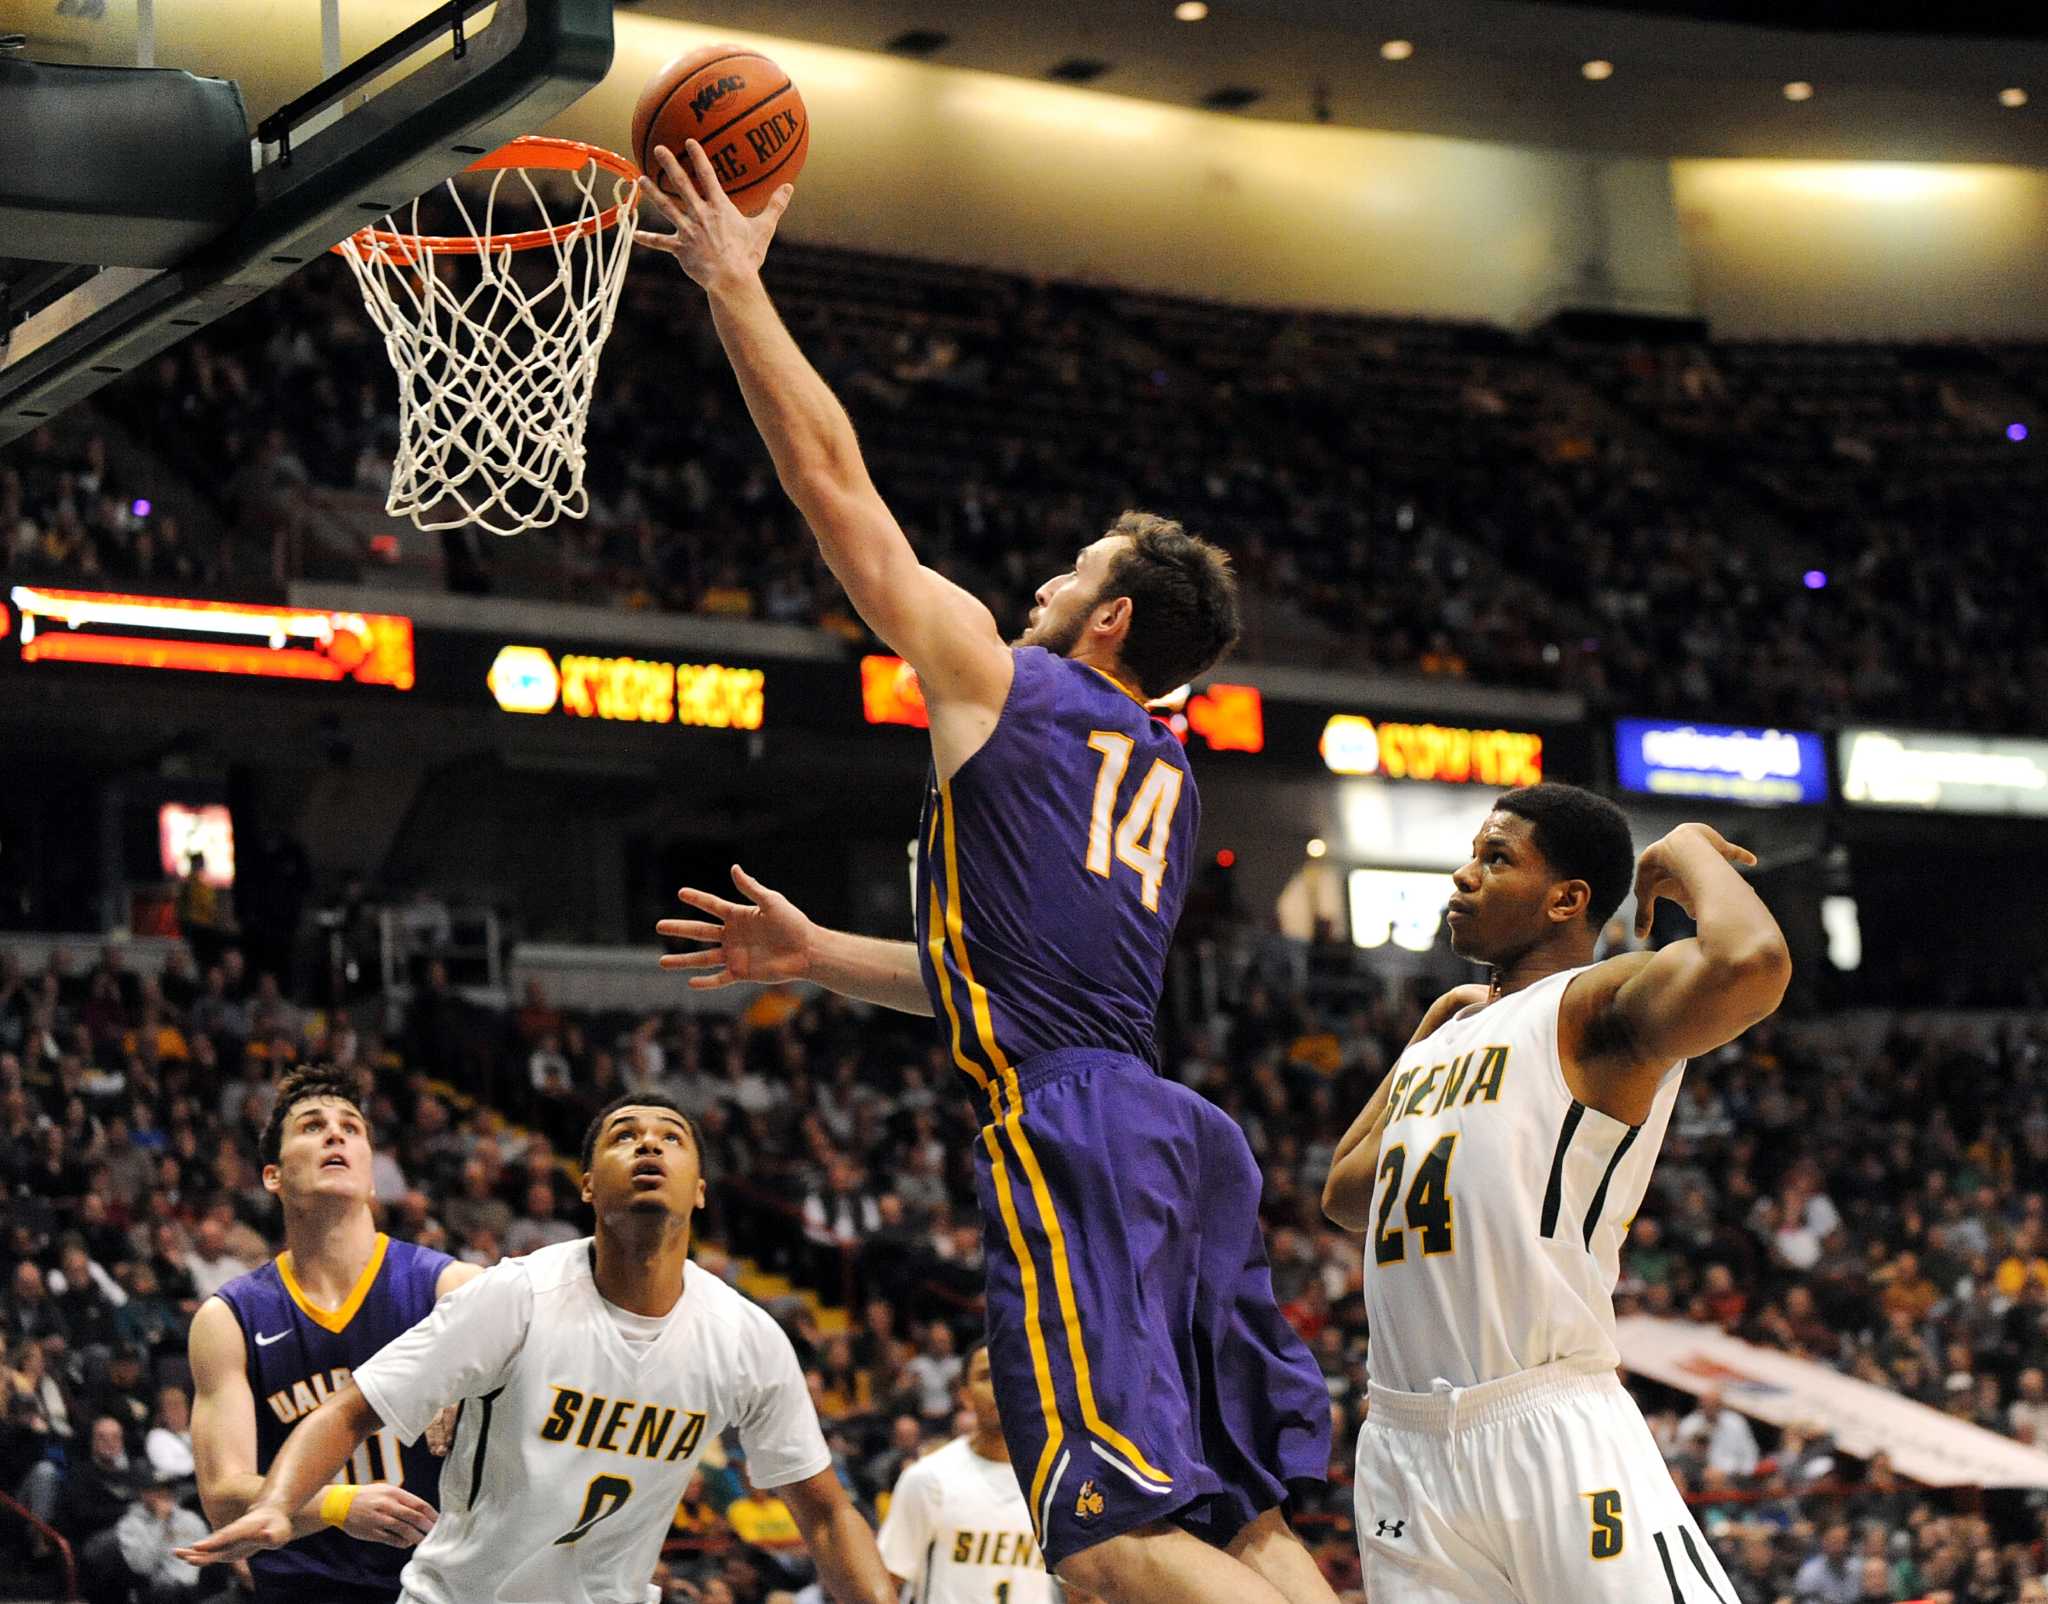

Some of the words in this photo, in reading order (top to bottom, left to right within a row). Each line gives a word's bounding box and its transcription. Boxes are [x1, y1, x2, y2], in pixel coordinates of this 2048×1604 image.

[711, 142, 748, 183] HE
[745, 108, 799, 165] ROCK
[1086, 730, 1184, 914] 14
[1384, 1045, 1512, 1128] SIENA
[1375, 1131, 1461, 1267] 24
[540, 1384, 708, 1462] SIENA
[553, 1472, 635, 1546] 0
[951, 1526, 1045, 1569] SIEN
